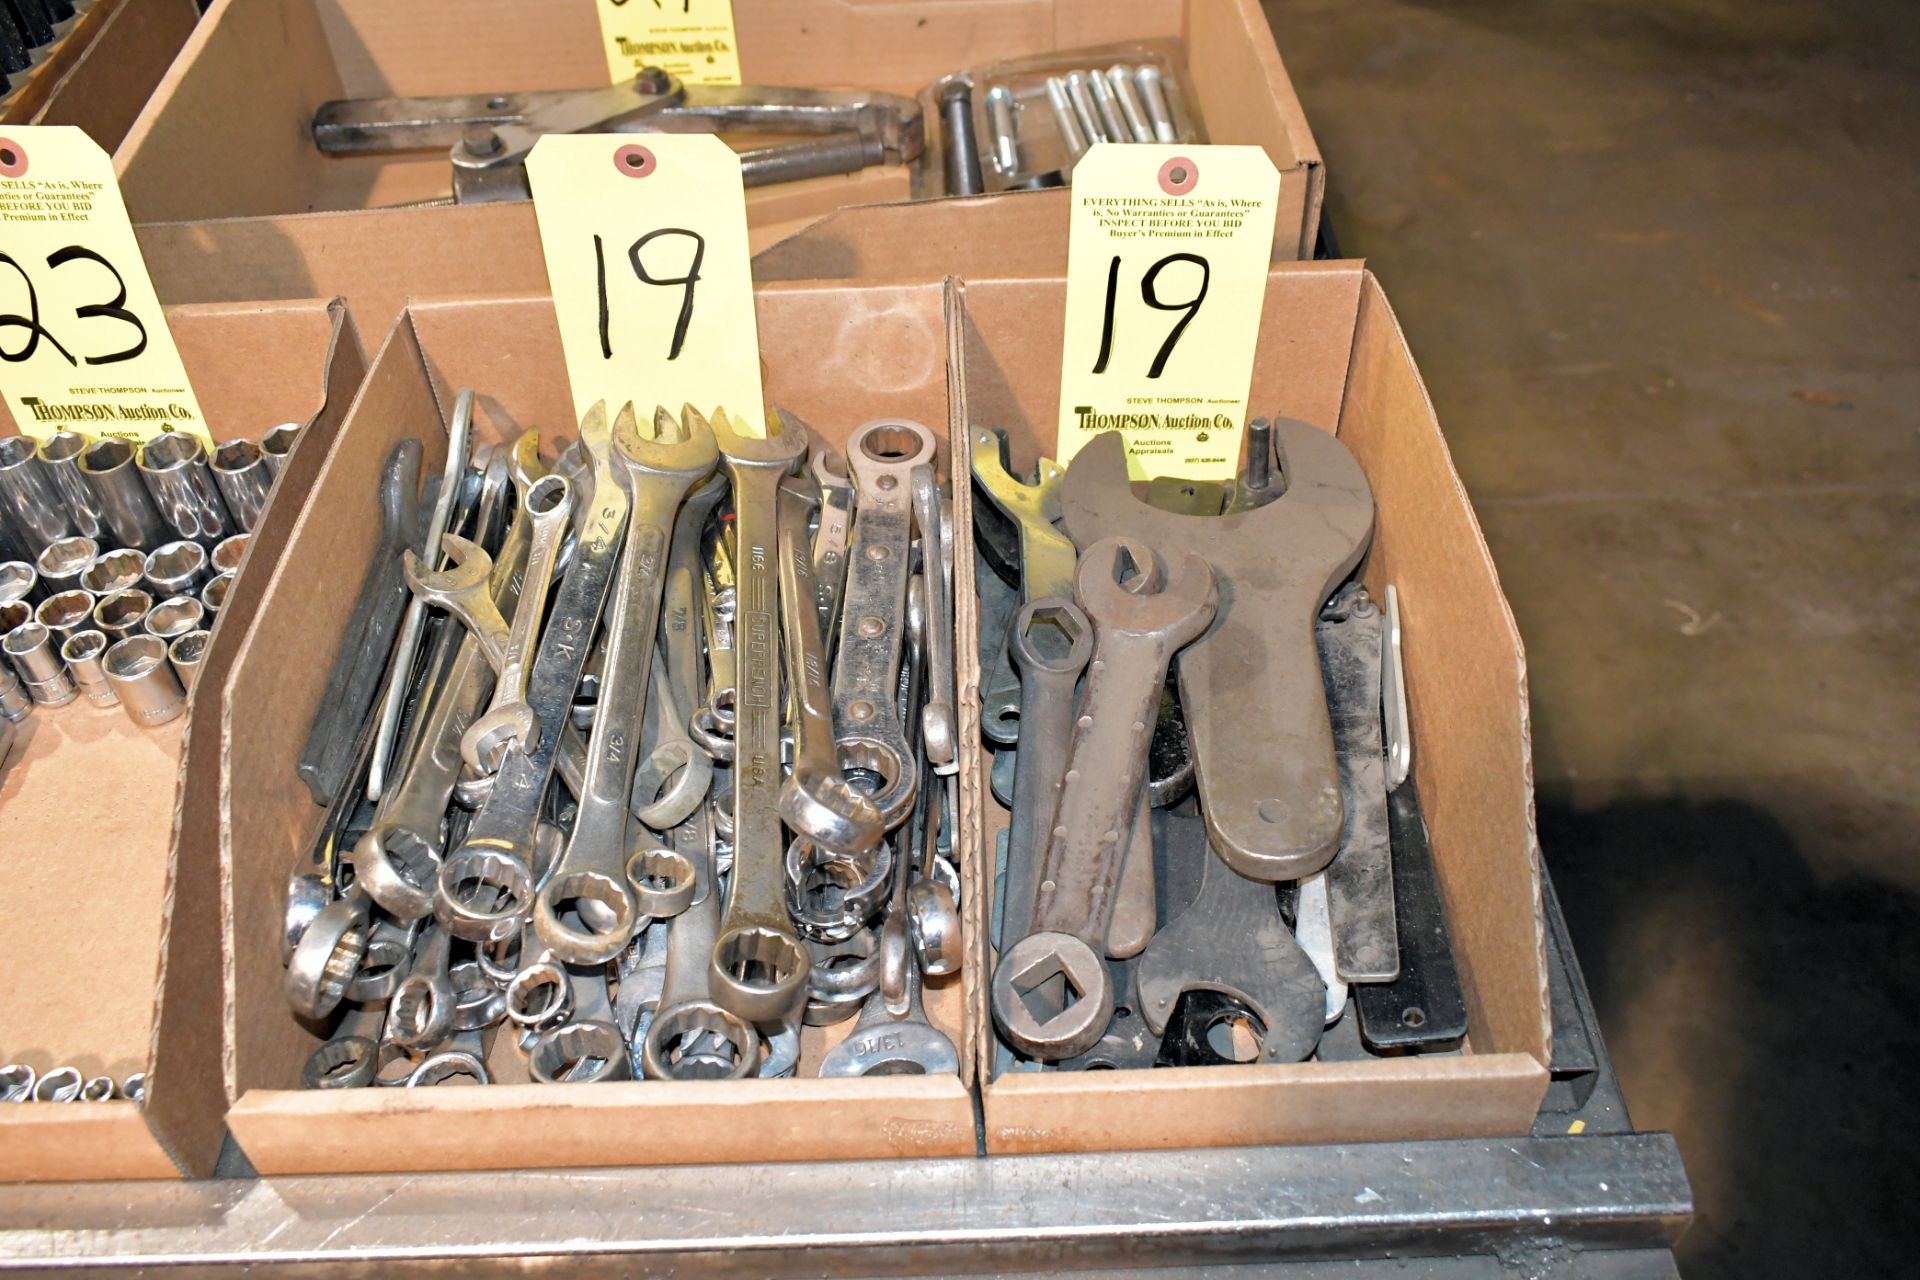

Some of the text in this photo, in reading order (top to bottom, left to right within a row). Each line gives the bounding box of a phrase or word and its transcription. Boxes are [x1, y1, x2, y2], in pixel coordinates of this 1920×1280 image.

[615, 37, 678, 56] THOMPSON
[1, 181, 36, 190] SELLS
[70, 181, 103, 190] Where
[0, 202, 92, 211] BEFORE YOU BID
[1083, 198, 1157, 207] EVERYTHING
[1160, 198, 1195, 207] SELLS
[1230, 199, 1262, 208] Where
[2, 212, 89, 221] Premium in Effect
[1106, 208, 1120, 217] No
[1122, 208, 1175, 217] Warranties
[1099, 218, 1243, 228] INSPECT BEFORE YOU BID
[1148, 229, 1192, 238] Premium
[1194, 229, 1203, 238] in
[1206, 229, 1234, 238] Effect
[594, 228, 705, 360] 19
[1092, 252, 1210, 379] 19
[68, 387, 97, 395] STEVE
[1126, 397, 1153, 405] STEVE
[20, 396, 117, 422] THOMPSON
[118, 403, 168, 421] Auction
[1074, 405, 1160, 431] THOMPSON
[1162, 413, 1211, 430] Auction
[1128, 447, 1174, 455] Appraisals
[589, 507, 616, 553] 3/4
[671, 606, 688, 632] 7/8
[605, 733, 625, 764] 3/4
